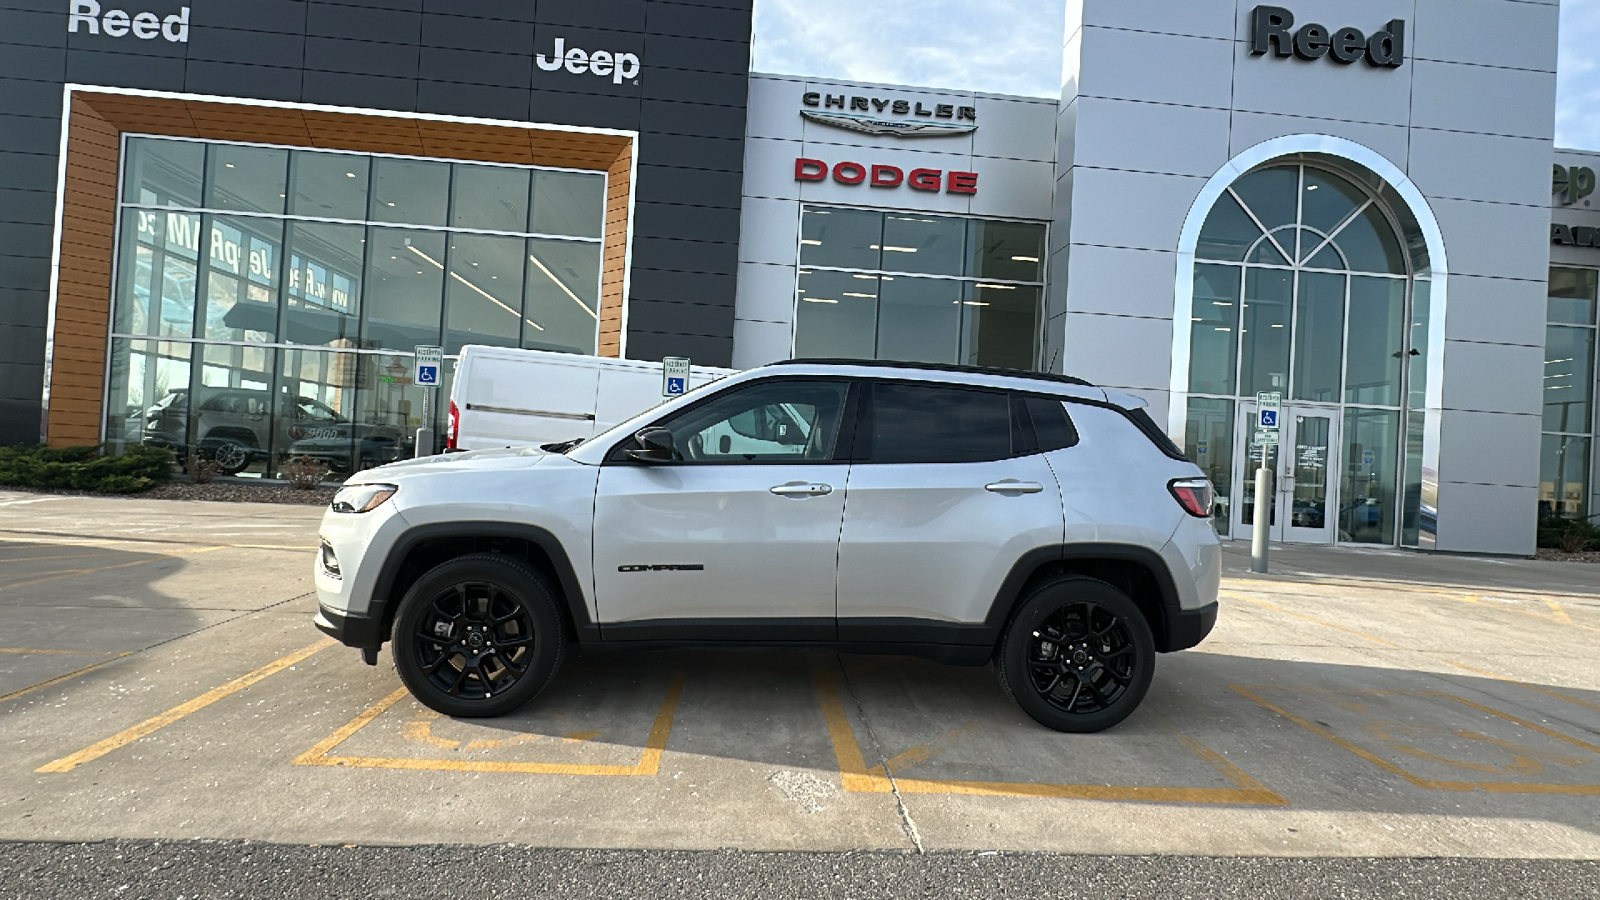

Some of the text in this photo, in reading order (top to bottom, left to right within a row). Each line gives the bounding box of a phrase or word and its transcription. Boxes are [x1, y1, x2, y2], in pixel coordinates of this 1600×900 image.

[68, 0, 190, 43] Reed
[1250, 5, 1405, 68] Reed
[536, 37, 640, 85] Jeep
[802, 92, 977, 120] CHRYSLER
[795, 157, 979, 195] DODGE
[1552, 163, 1596, 206] ep
[618, 564, 704, 572] COMPASS
